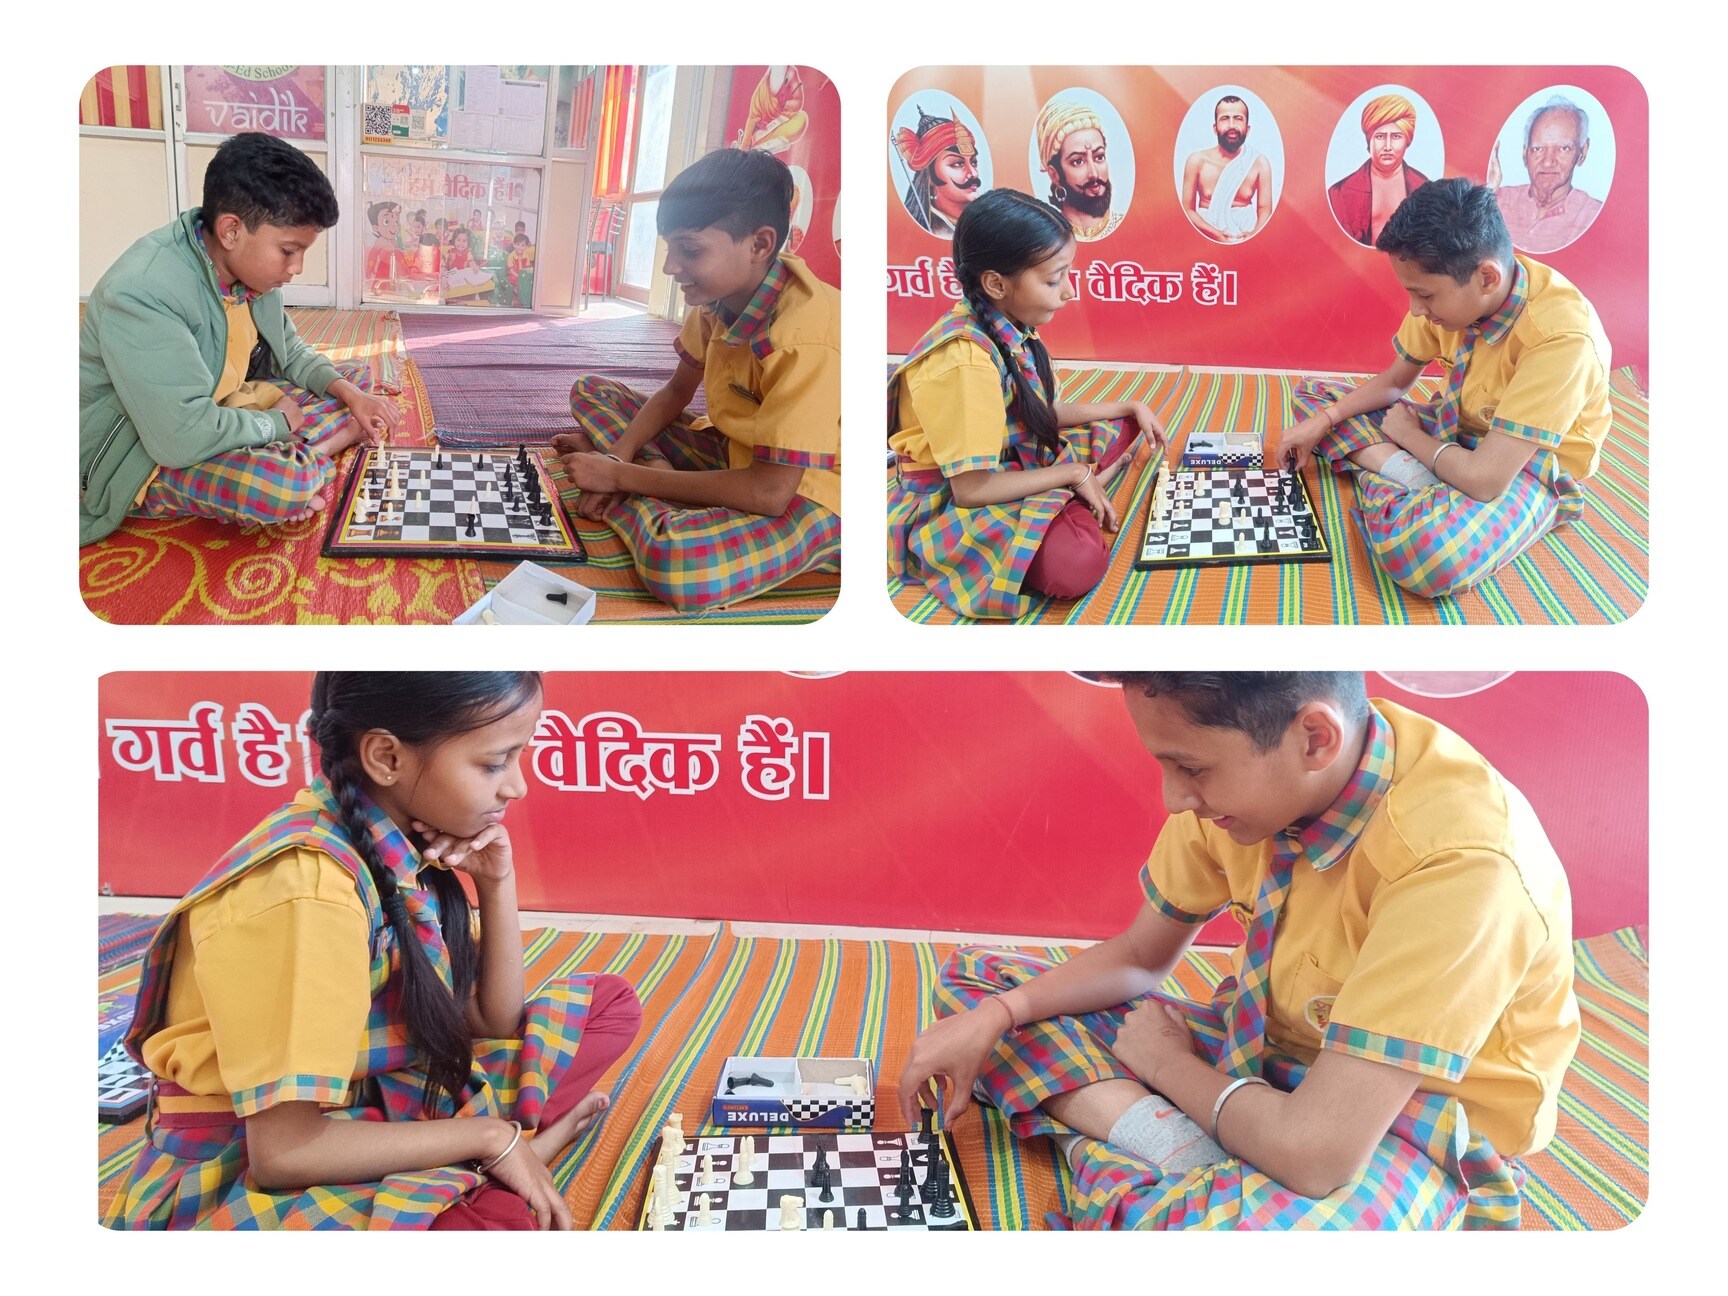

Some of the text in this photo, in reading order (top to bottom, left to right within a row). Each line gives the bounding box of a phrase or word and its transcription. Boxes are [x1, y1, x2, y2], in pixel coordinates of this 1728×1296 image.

[203, 87, 308, 133] vaidik
[1088, 261, 1182, 304] वैदिक
[106, 701, 224, 783] गर्व
[233, 703, 291, 787] है
[530, 711, 721, 801] वैदिक
[727, 1112, 789, 1122] DELUXE
